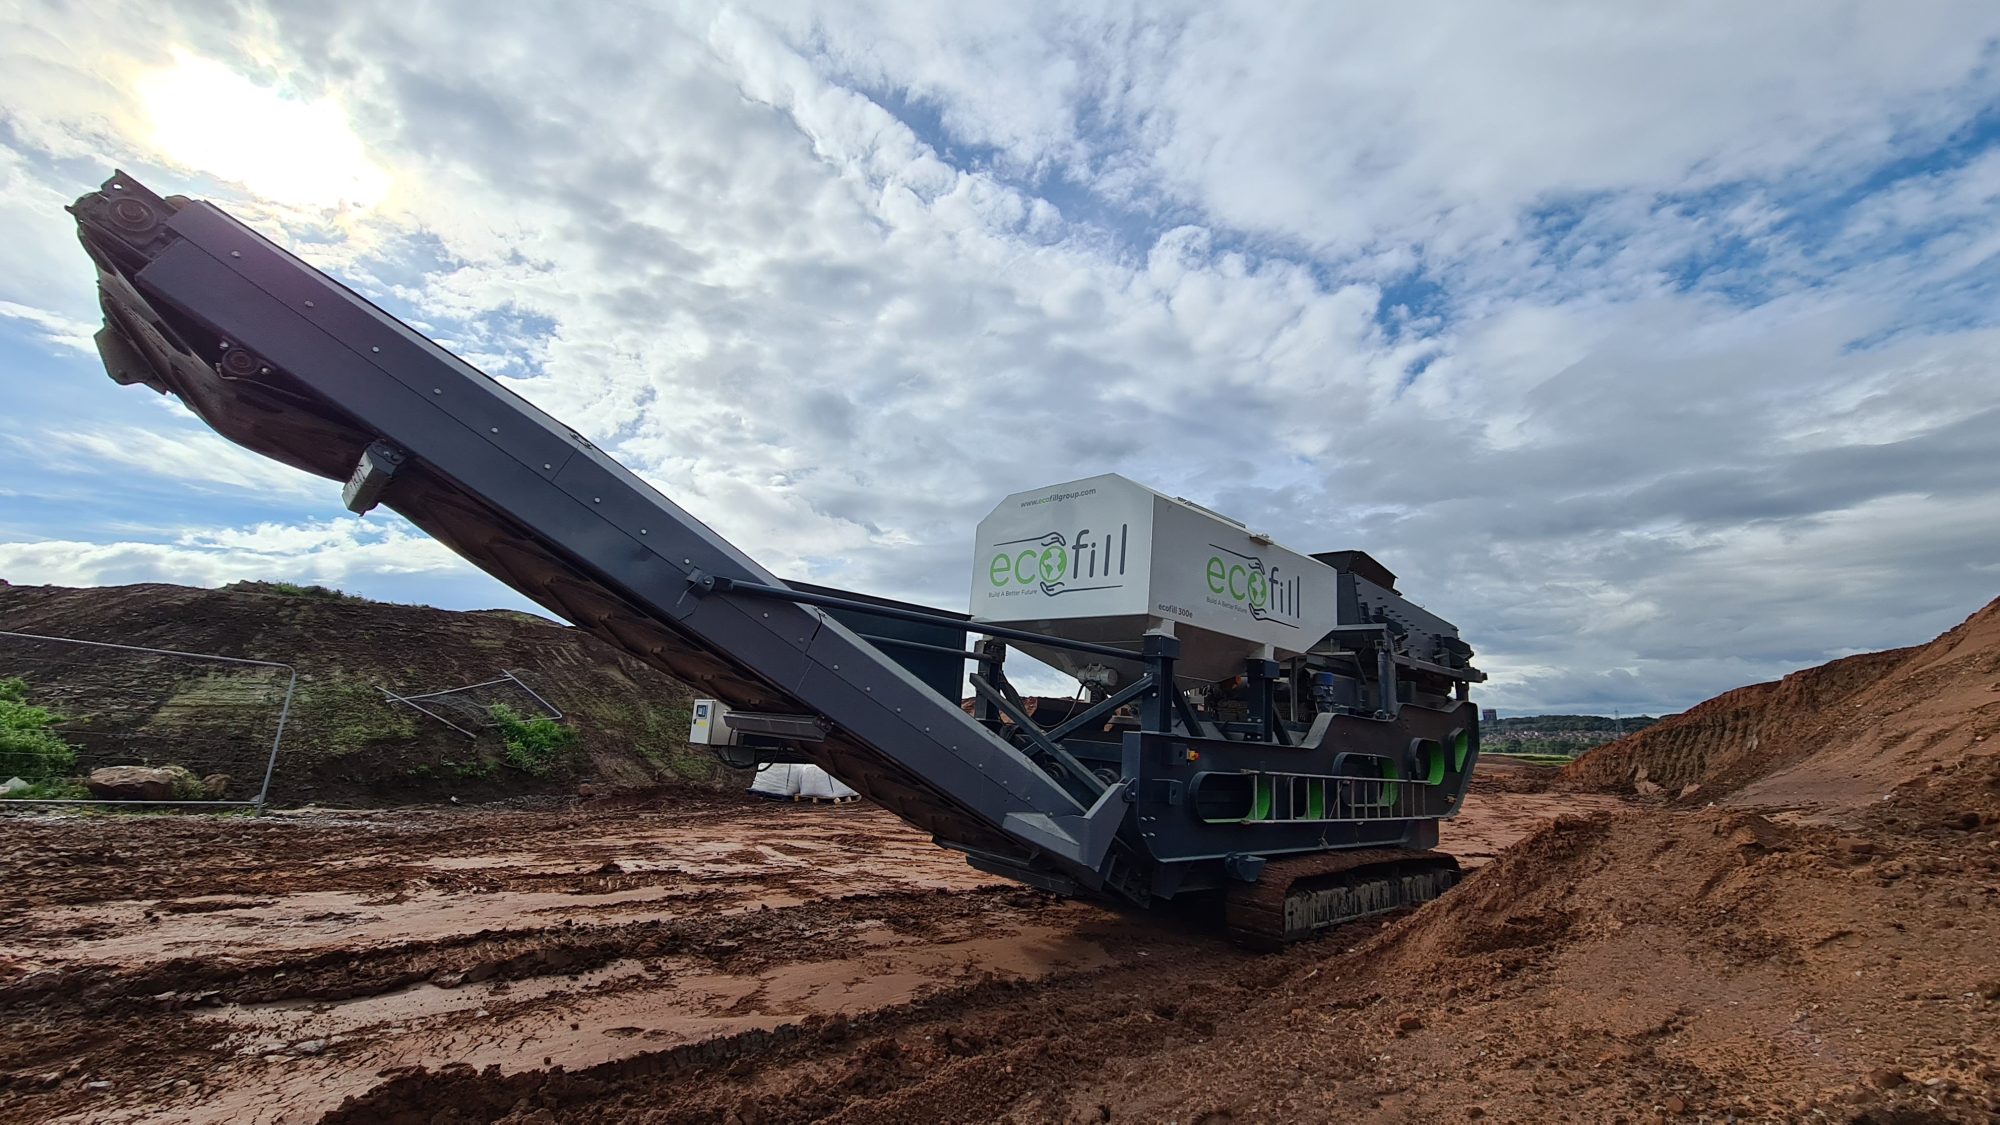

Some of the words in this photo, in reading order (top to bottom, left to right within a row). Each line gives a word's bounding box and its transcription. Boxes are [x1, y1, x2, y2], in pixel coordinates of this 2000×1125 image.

[1020, 488, 1096, 508] www.ecofillgroup.com
[989, 523, 1128, 587] ecofill
[1206, 556, 1300, 619] ecofill
[1158, 604, 1178, 614] ecofill
[1178, 608, 1193, 618] 300e
